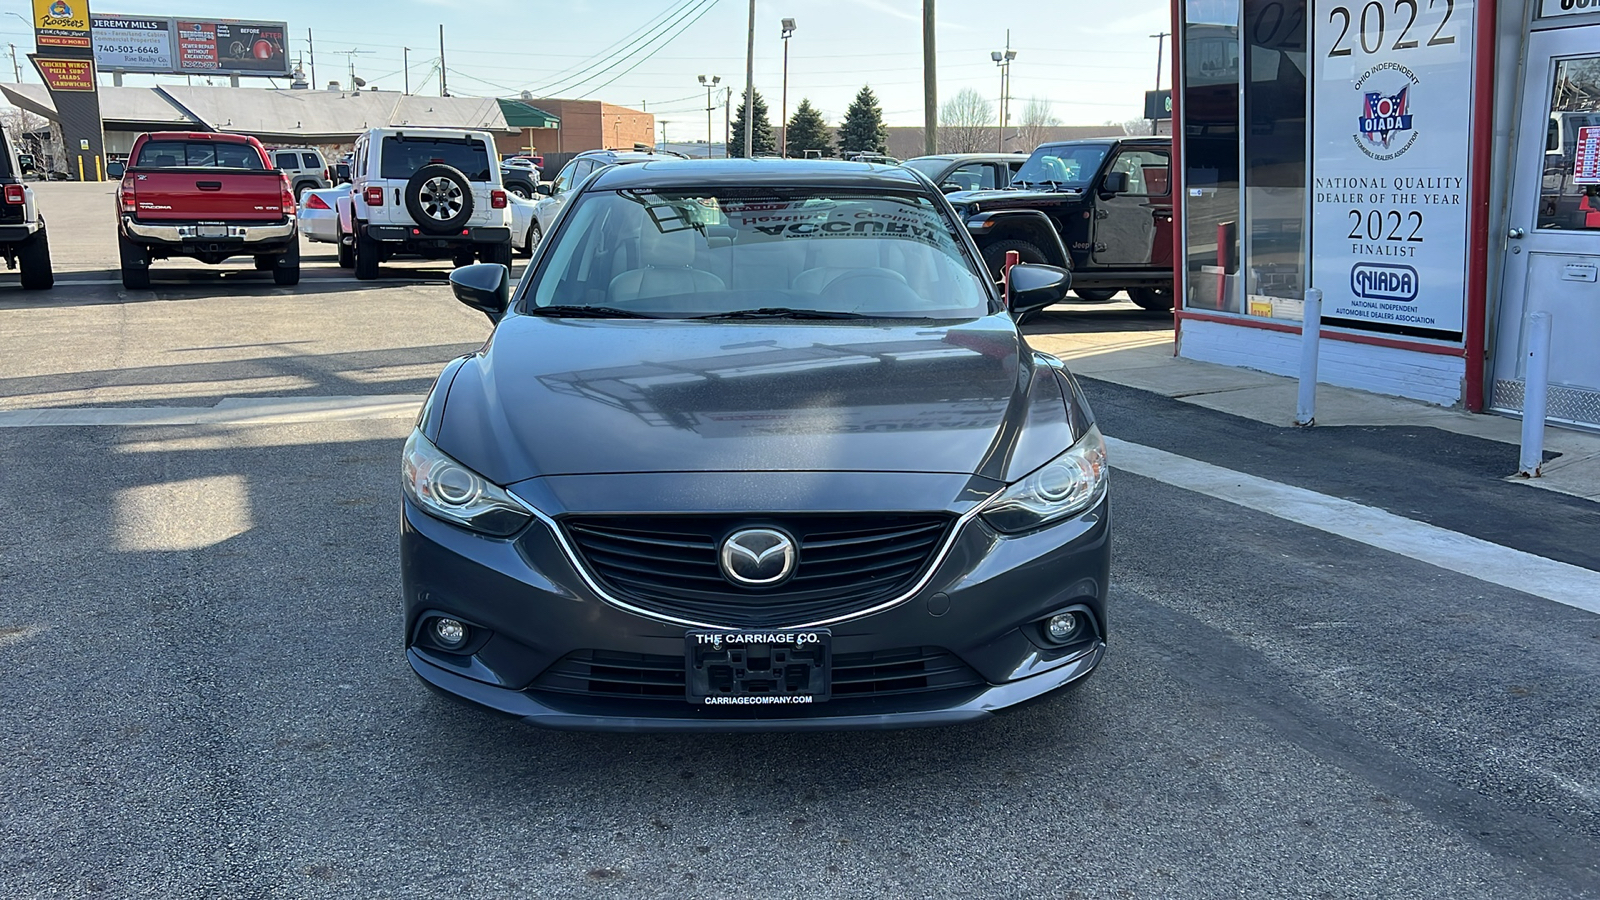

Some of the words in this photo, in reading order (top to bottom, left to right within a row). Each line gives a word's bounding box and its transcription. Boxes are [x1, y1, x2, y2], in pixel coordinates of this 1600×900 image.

[41, 15, 84, 28] Roosters
[94, 20, 131, 28] JEREMY
[132, 21, 158, 29] MILLS
[1328, 0, 1455, 58] 2022
[98, 45, 159, 54] 740-503-6648
[1355, 71, 1370, 90] OHIO
[1371, 62, 1420, 85] INDEPENDENT
[1365, 116, 1403, 131] OIADA
[1353, 134, 1374, 158] AUTOMOBILE
[1394, 131, 1419, 158] ASSOCIATION
[1316, 178, 1387, 188] NATIONAL
[1394, 177, 1463, 190] QUALITY
[1317, 192, 1364, 204] DEALER
[1370, 194, 1386, 204] OF
[1392, 194, 1418, 204] THE
[1424, 194, 1460, 204] YEAR
[1348, 209, 1424, 242] 2022
[1072, 241, 1090, 250] Jeep
[1352, 244, 1416, 257] FINALIST
[1356, 270, 1412, 294] NIADA
[1352, 301, 1378, 309] NATIONAL
[1380, 303, 1418, 312] INDEPENDENT
[1336, 308, 1370, 318] AUTOMOBILE
[1370, 312, 1394, 320] DEALERS
[1396, 315, 1435, 324] ASSOCIATION
[696, 634, 723, 644] THE
[726, 634, 794, 644] CARRIAGE
[797, 633, 820, 644] CO.
[704, 696, 813, 705] CARRIAGECOMPANY.COM
